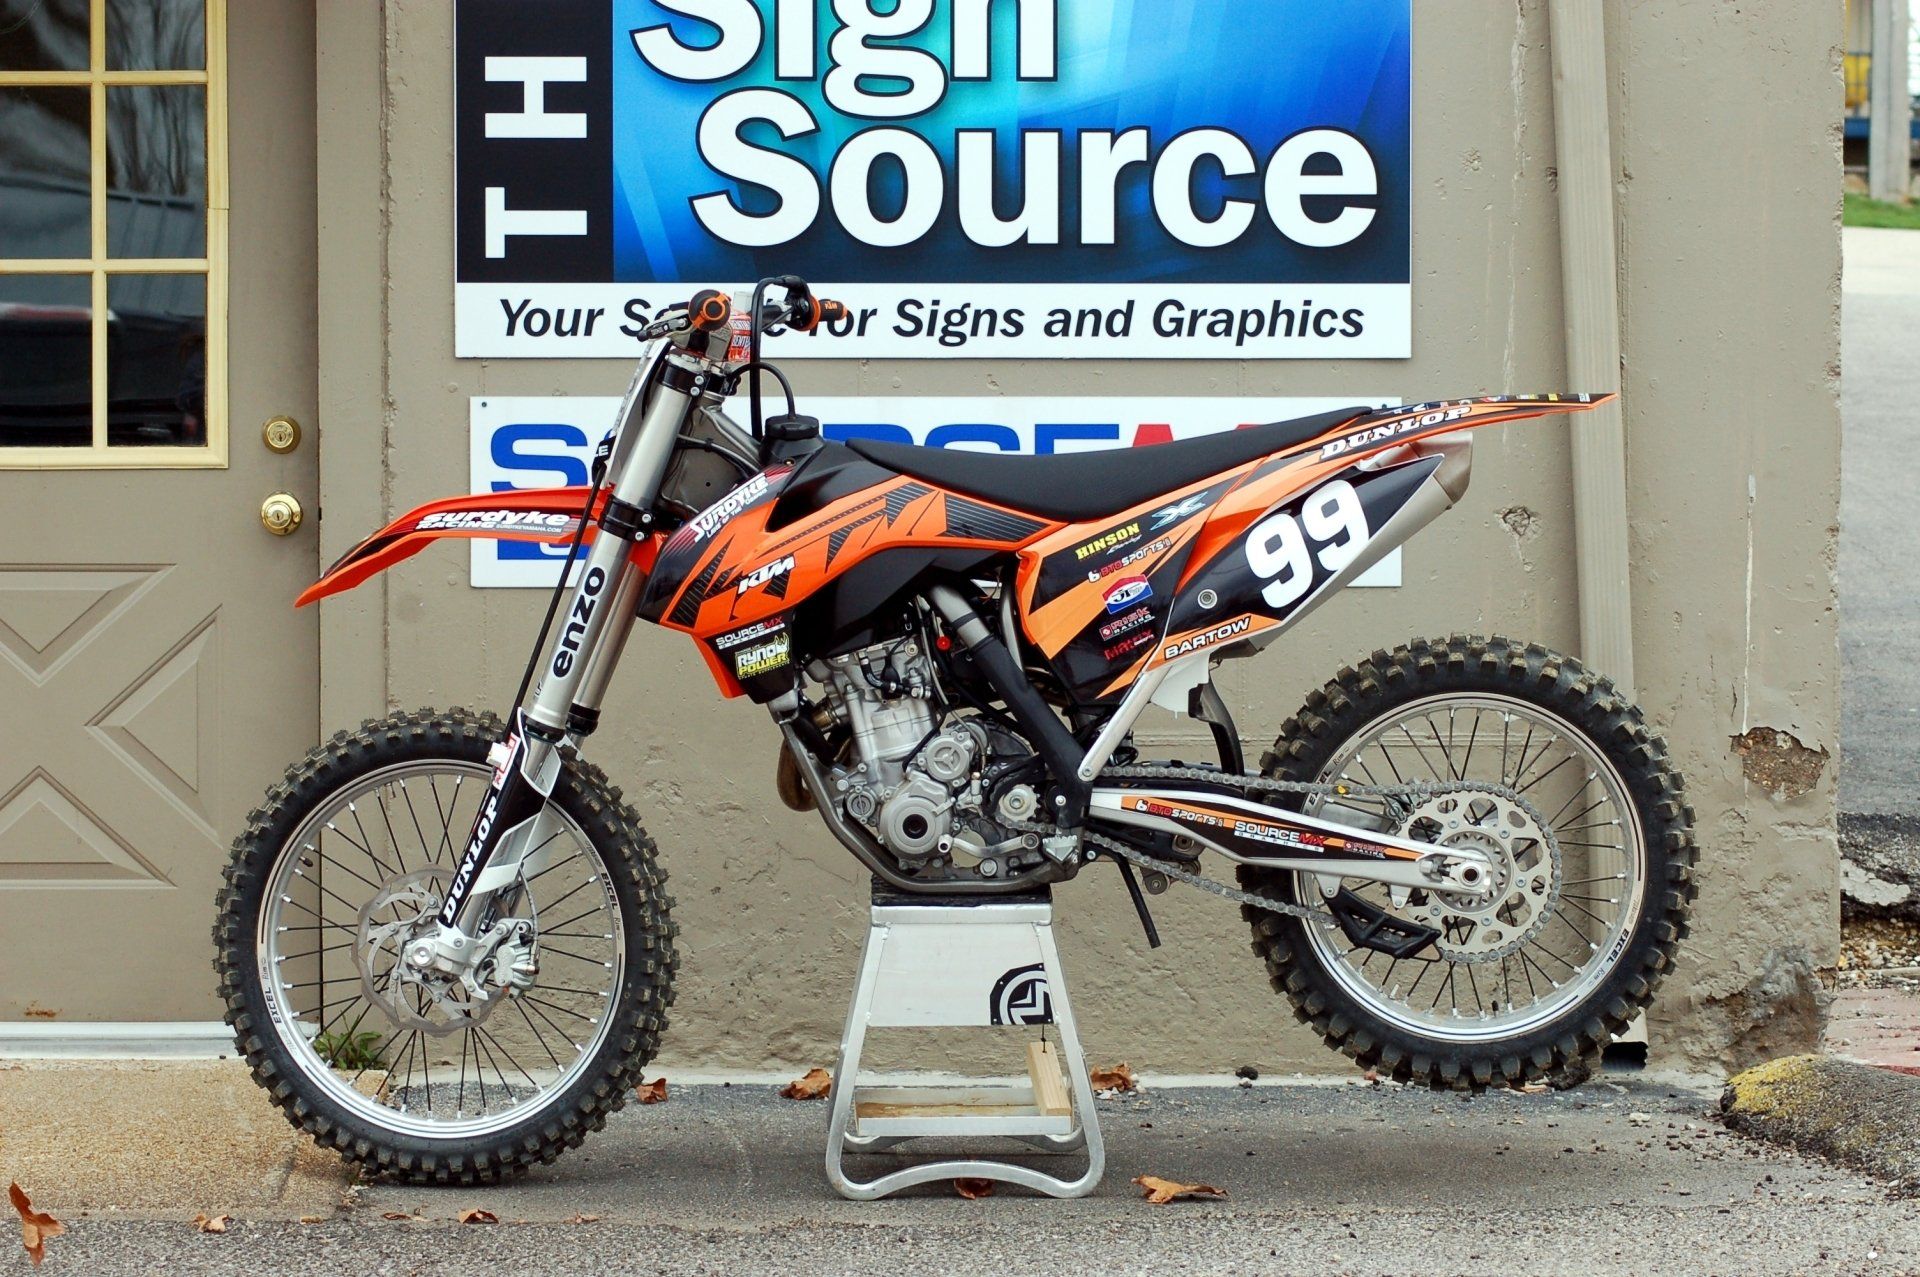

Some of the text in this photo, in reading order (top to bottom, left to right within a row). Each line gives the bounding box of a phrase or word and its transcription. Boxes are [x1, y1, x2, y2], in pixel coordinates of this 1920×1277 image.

[690, 89, 1379, 249] Source
[500, 298, 605, 338] Your
[892, 298, 1025, 347] Signs
[1043, 299, 1135, 338] and
[1152, 299, 1364, 347] Graphics
[1321, 406, 1472, 460] DUNLOP
[415, 520, 498, 530] RACING
[423, 509, 571, 526] surdyke
[690, 473, 769, 543] SURDYKE
[1075, 522, 1140, 560] HINSON
[1245, 479, 1370, 609] 99
[738, 555, 795, 595] KTM
[552, 566, 606, 678] enzo
[715, 616, 783, 647] SOURCEMX
[1164, 615, 1252, 660] BARTOW
[738, 653, 787, 677] POWER
[1234, 821, 1328, 847] SOURCEMX
[443, 796, 497, 924] DUNLOP
[600, 872, 619, 911] EXCEL
[1606, 928, 1631, 964] EXCEL
[264, 987, 282, 1025] EXCEL
